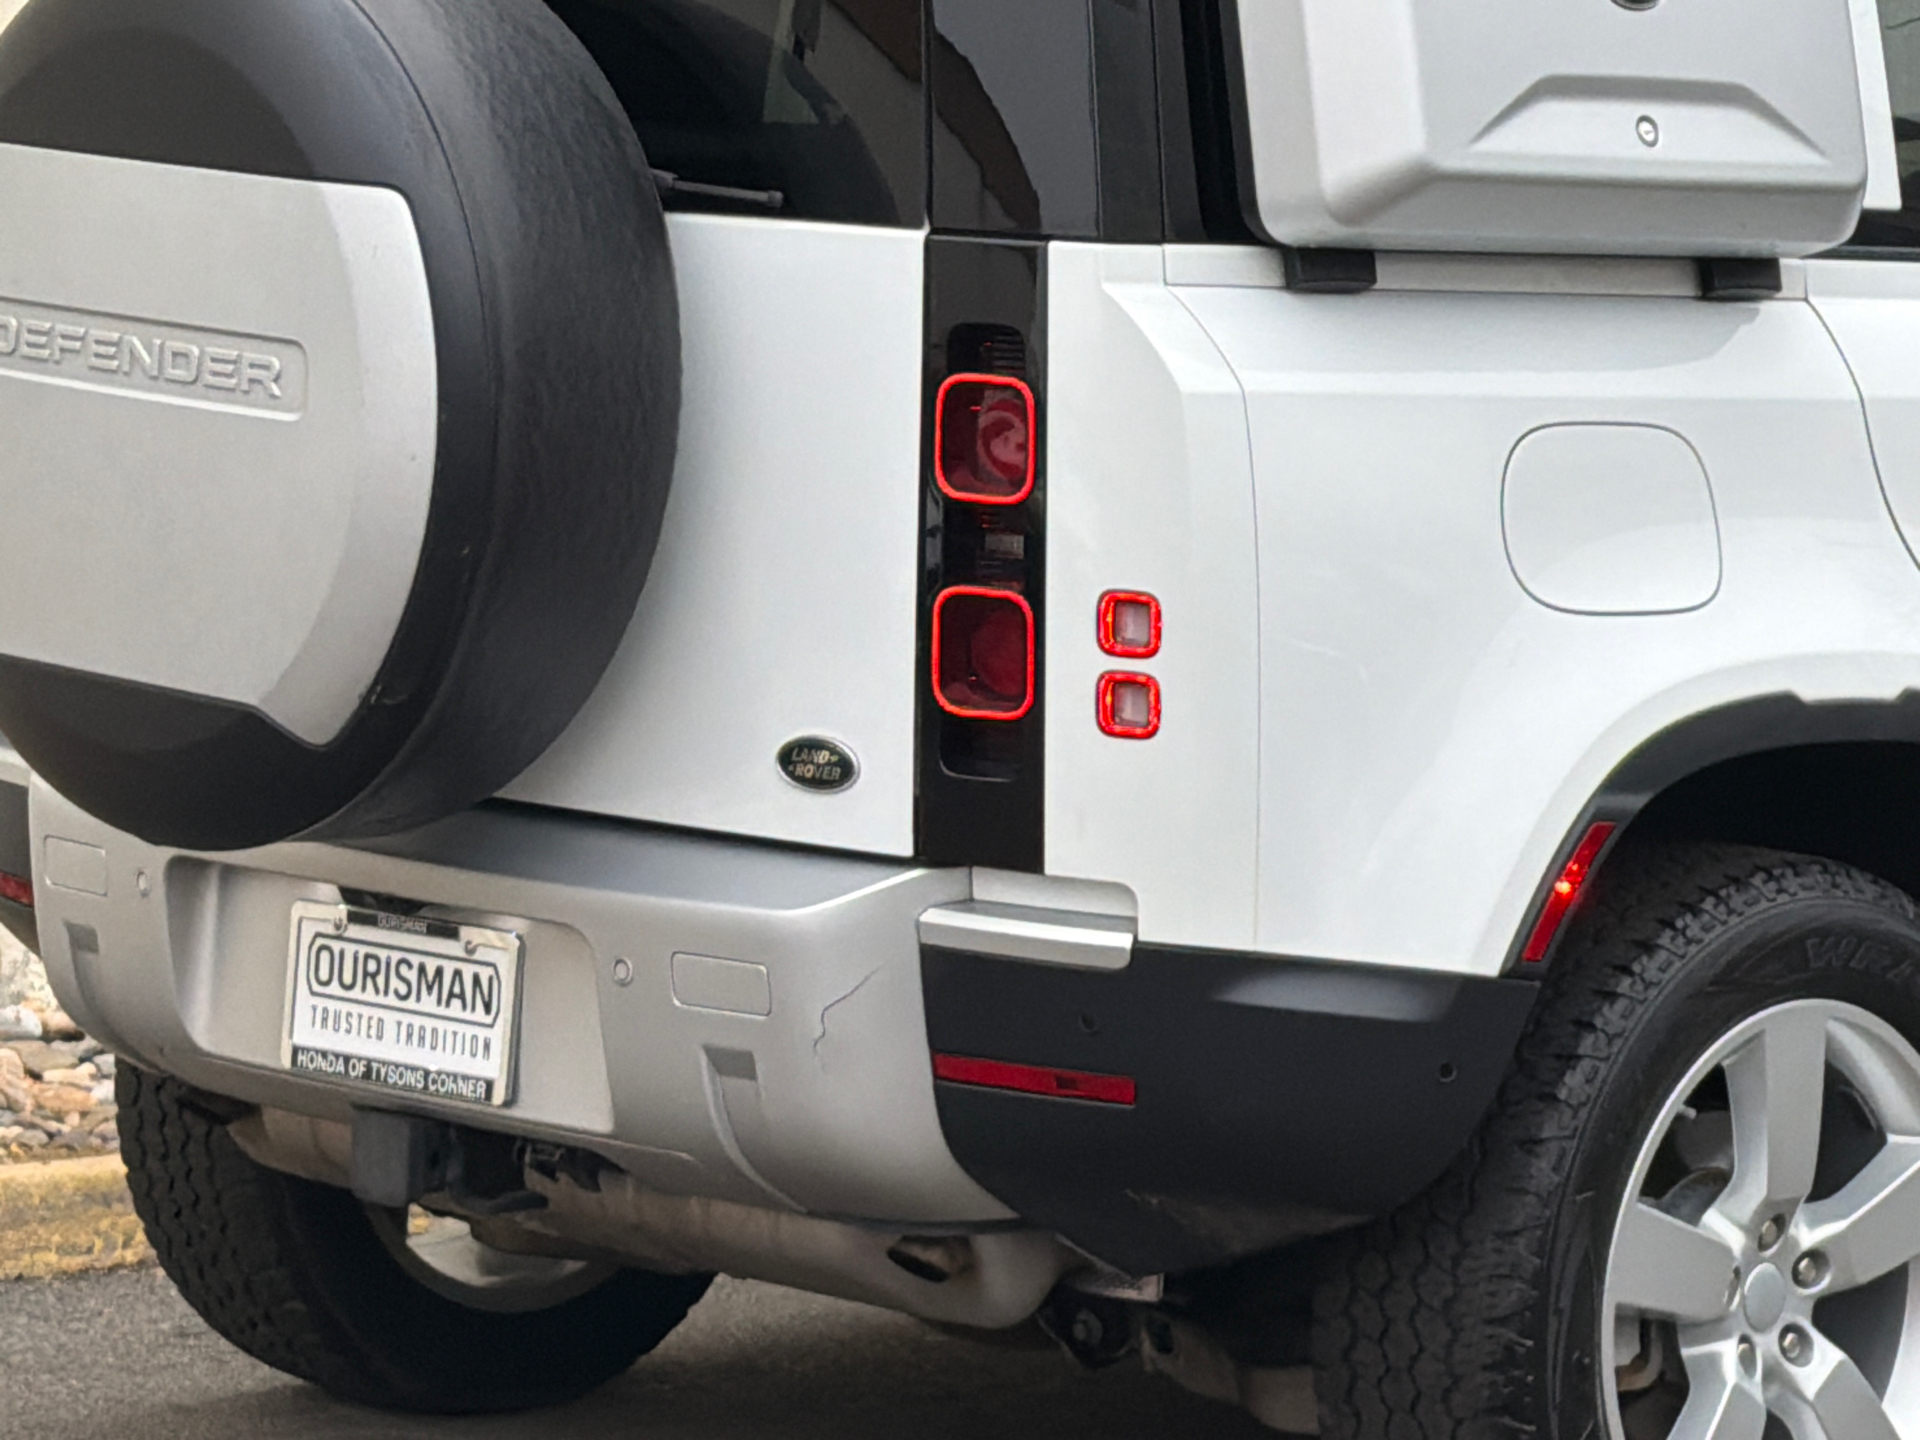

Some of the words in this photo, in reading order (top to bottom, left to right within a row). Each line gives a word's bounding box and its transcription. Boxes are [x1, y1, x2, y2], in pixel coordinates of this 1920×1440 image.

[791, 747, 830, 764] LAND
[795, 763, 841, 780] ROVER
[313, 944, 494, 1016] OURISMAN
[311, 1004, 385, 1041] TRUSTED
[396, 1021, 492, 1061] TRADITION
[297, 1050, 346, 1075] HONDA
[348, 1061, 367, 1078] OF
[370, 1062, 425, 1088] TYSONS
[428, 1073, 487, 1099] CORNER
